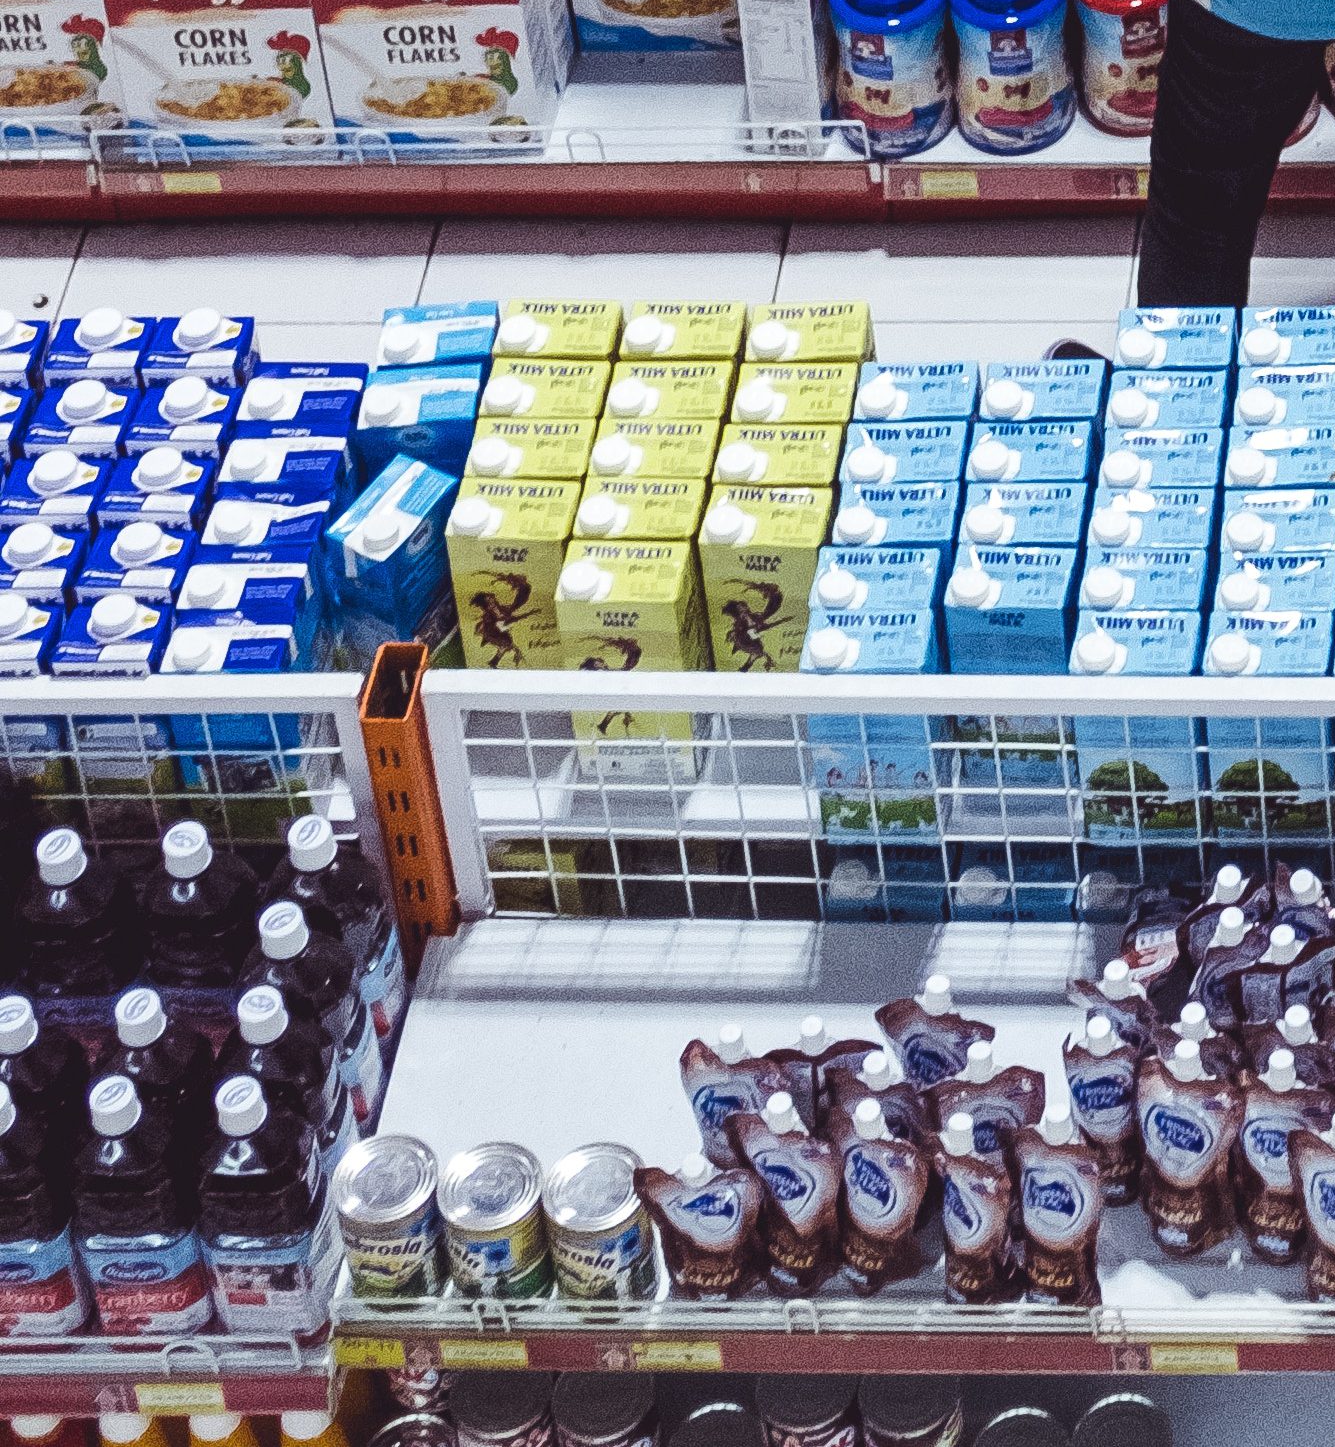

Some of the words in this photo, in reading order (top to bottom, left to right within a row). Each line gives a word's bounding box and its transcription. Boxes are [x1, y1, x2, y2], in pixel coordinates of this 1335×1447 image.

[174, 29, 247, 48] CORN
[383, 26, 456, 45] CORN
[179, 51, 251, 66] FLAKES
[387, 44, 460, 63] FLAKES
[826, 615, 863, 626] MILK
[869, 614, 916, 626] ULTRA
